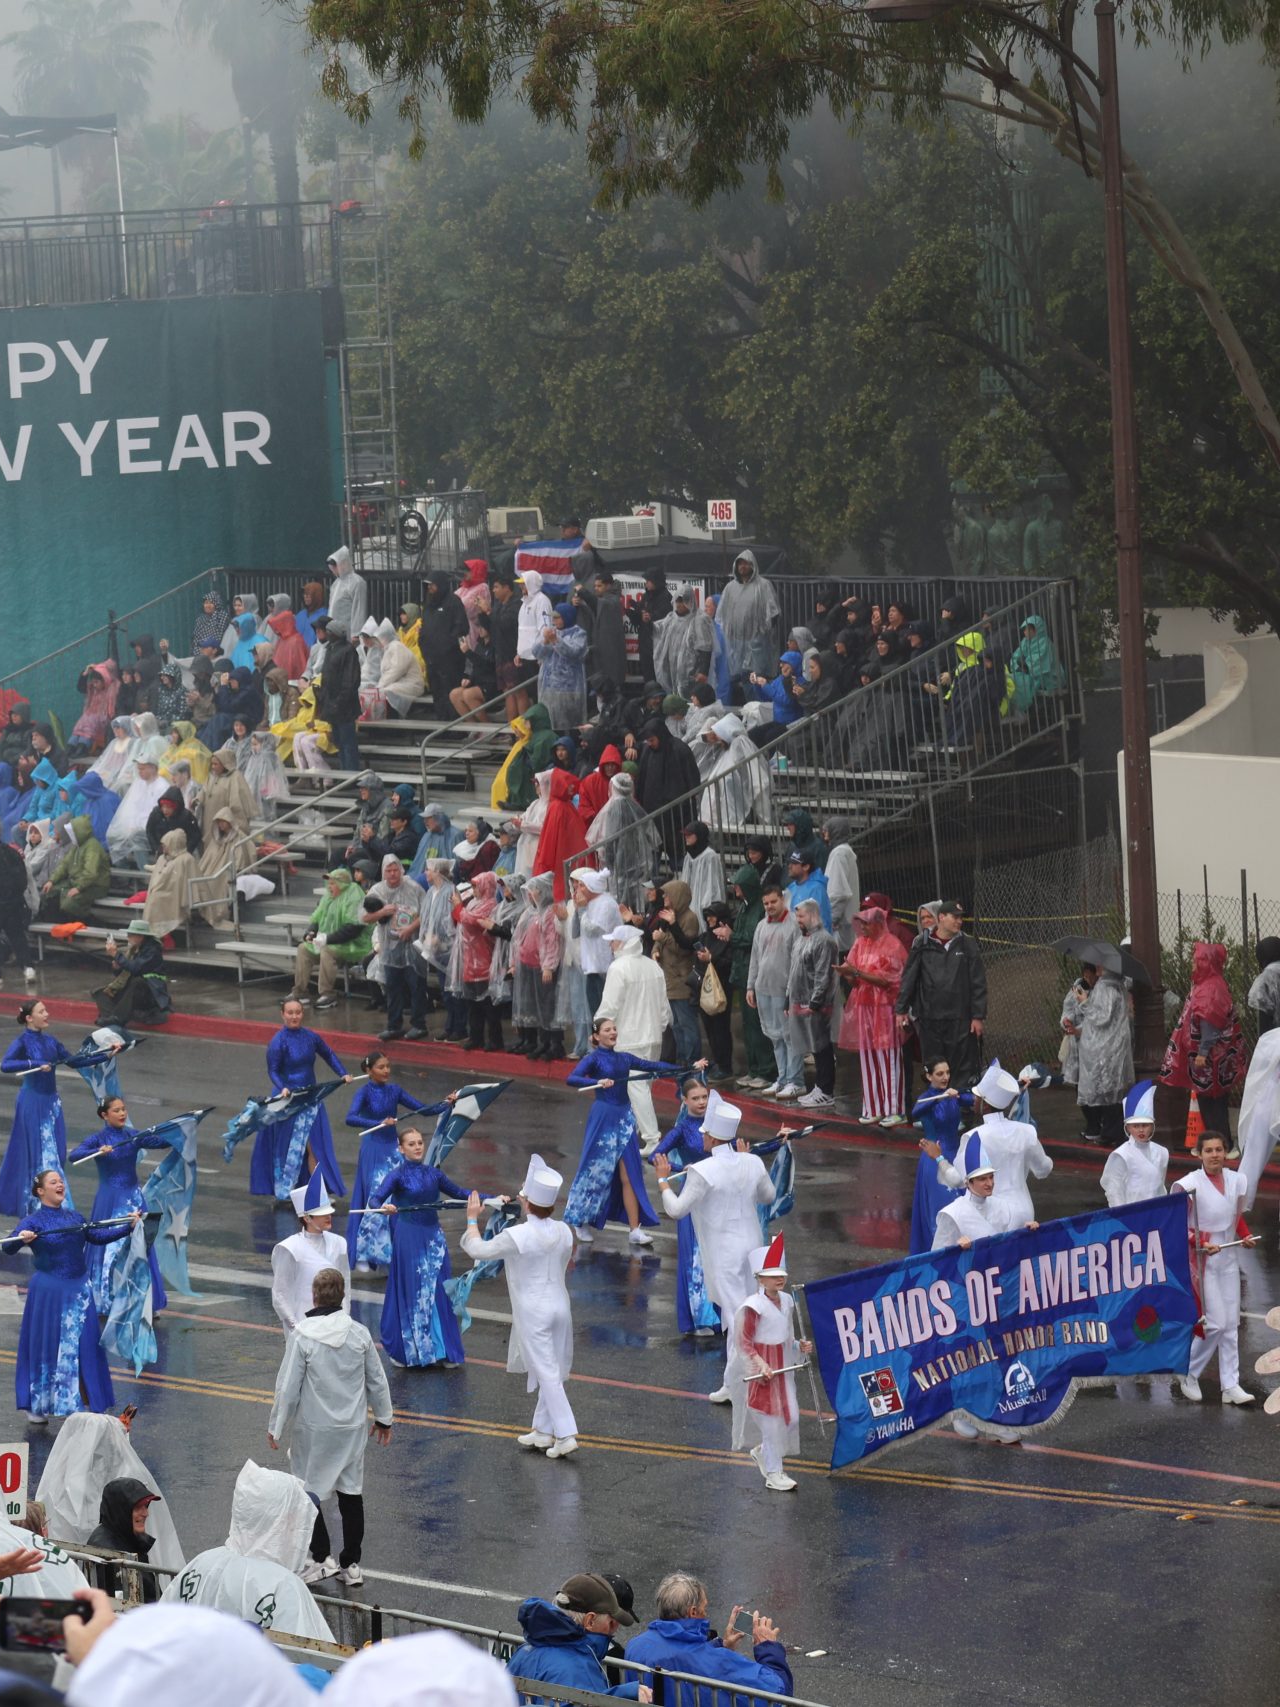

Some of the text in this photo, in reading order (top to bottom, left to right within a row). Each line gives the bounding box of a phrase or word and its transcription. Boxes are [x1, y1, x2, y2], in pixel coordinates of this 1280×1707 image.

[58, 411, 272, 477] YEAR
[711, 502, 732, 520] 465
[834, 1229, 1167, 1364] BANDS OF AMERICA
[912, 1321, 1108, 1392] NATIONAL HONOR BAND
[998, 1397, 1030, 1414] Music
